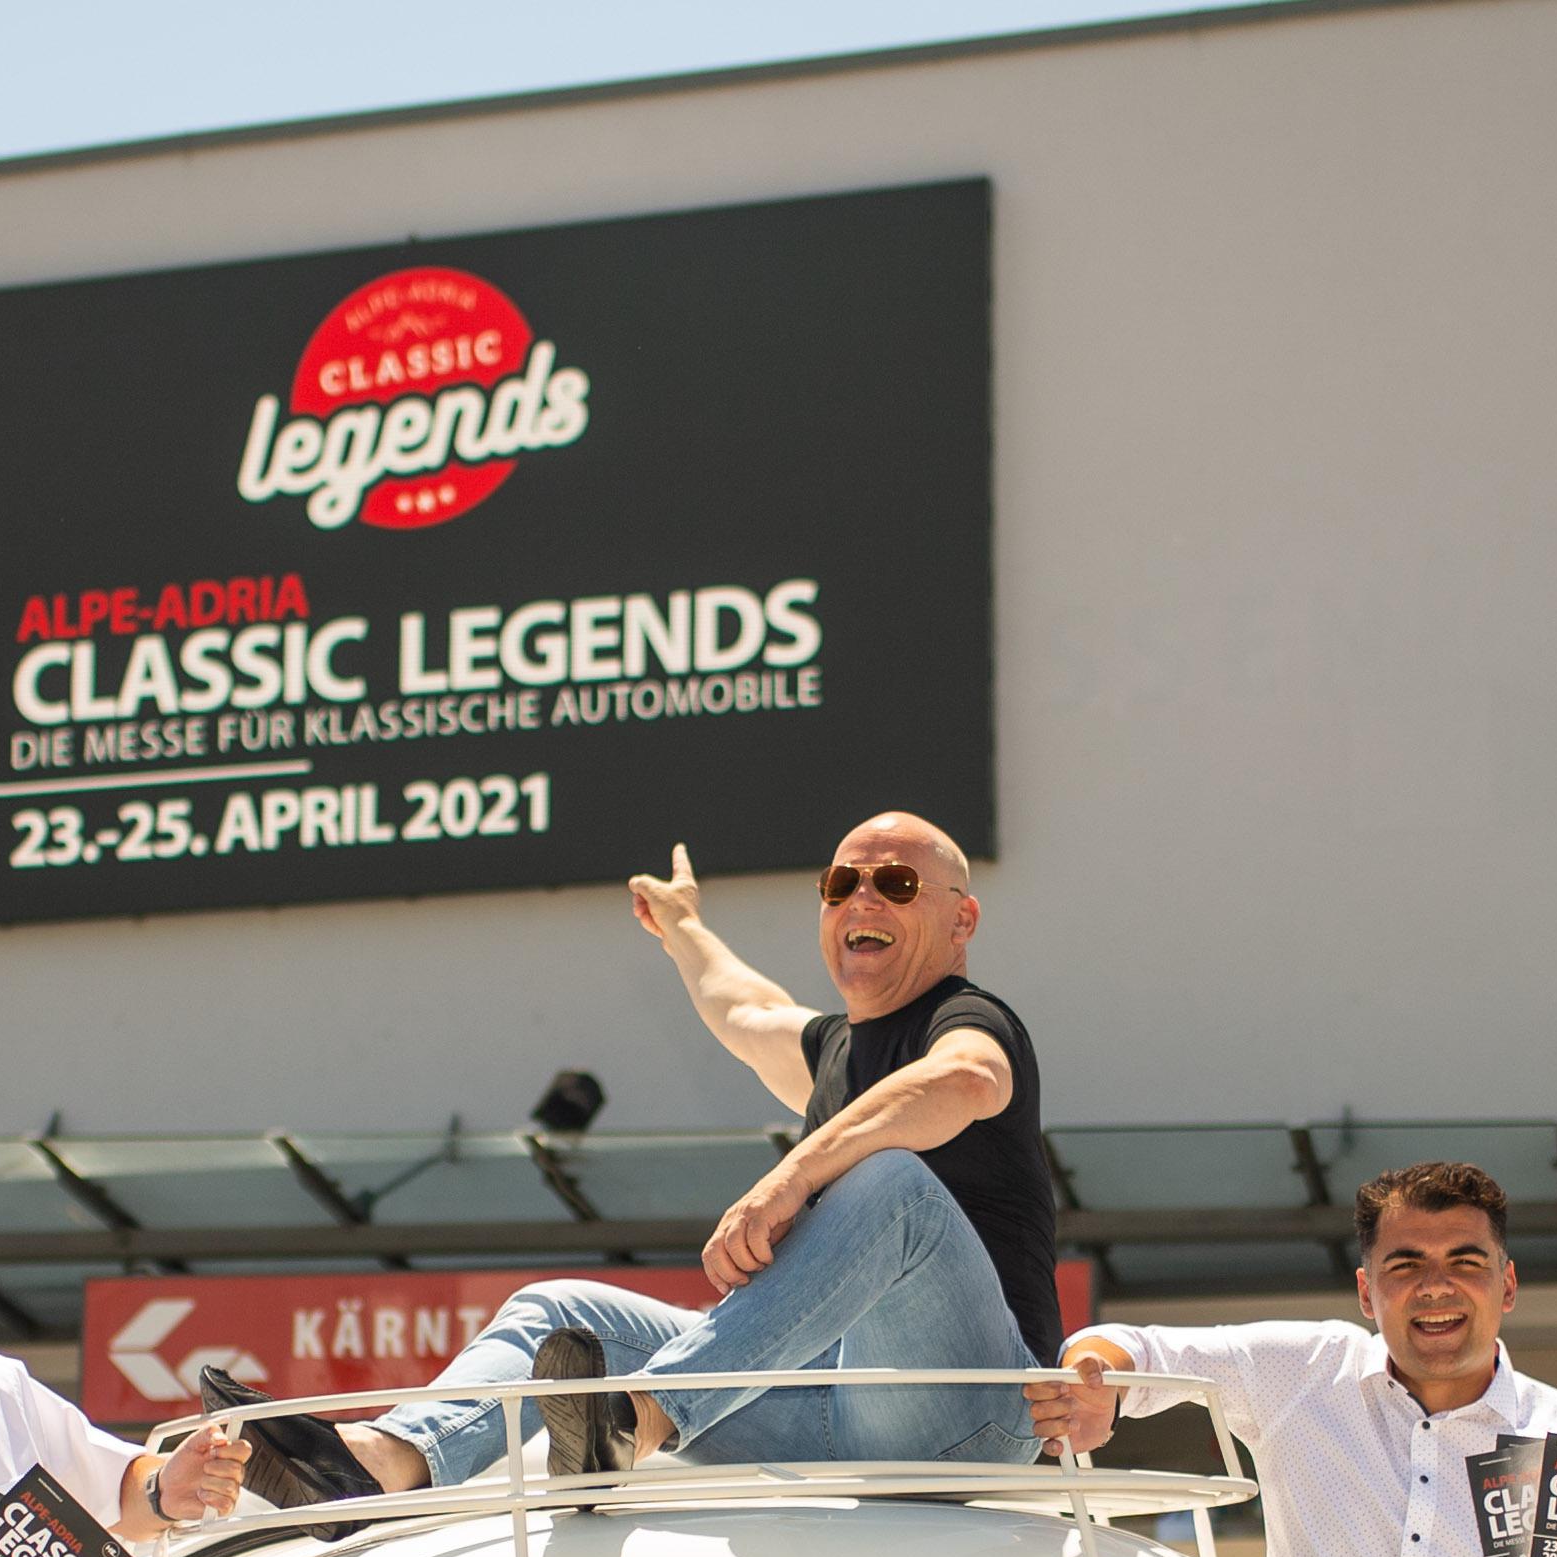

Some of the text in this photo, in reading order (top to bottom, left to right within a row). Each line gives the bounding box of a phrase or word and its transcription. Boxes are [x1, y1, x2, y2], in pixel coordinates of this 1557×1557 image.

[319, 329, 502, 396] CLASSIC
[237, 341, 590, 528] legends
[12, 578, 822, 725] CLASSIC LEGENDS
[16, 573, 310, 643] ALPE-ADRIA
[10, 667, 822, 771] DIE MESSE FÜR KLASSISCHE AUTOMOBILE
[10, 773, 550, 868] 23.-25. APRIL 2021
[20, 1491, 84, 1553] ALPE-ADRIA
